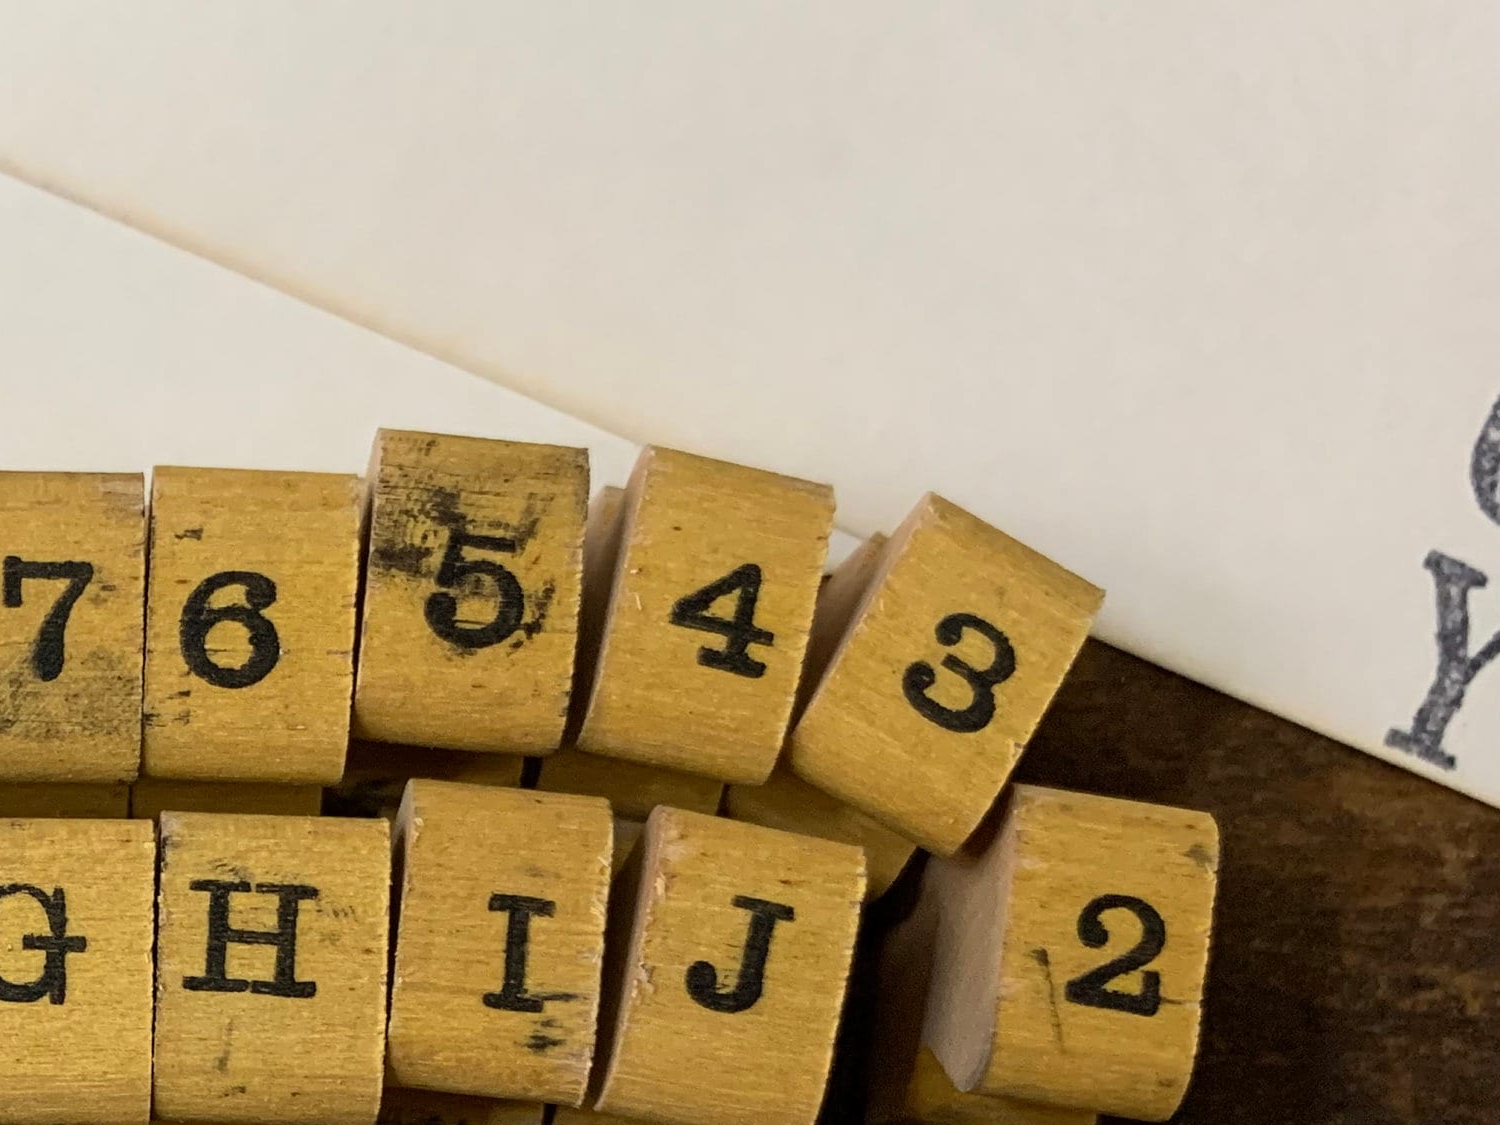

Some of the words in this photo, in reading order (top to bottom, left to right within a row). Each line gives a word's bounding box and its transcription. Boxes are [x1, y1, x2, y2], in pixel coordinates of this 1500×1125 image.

[2, 556, 95, 681] 7
[179, 570, 280, 689] 6
[423, 536, 527, 649] 5
[670, 562, 776, 679] 4
[900, 611, 1017, 734] 3
[182, 878, 320, 999] H
[483, 893, 556, 1013] I
[684, 894, 797, 1013] J
[1064, 892, 1168, 1014] 2
